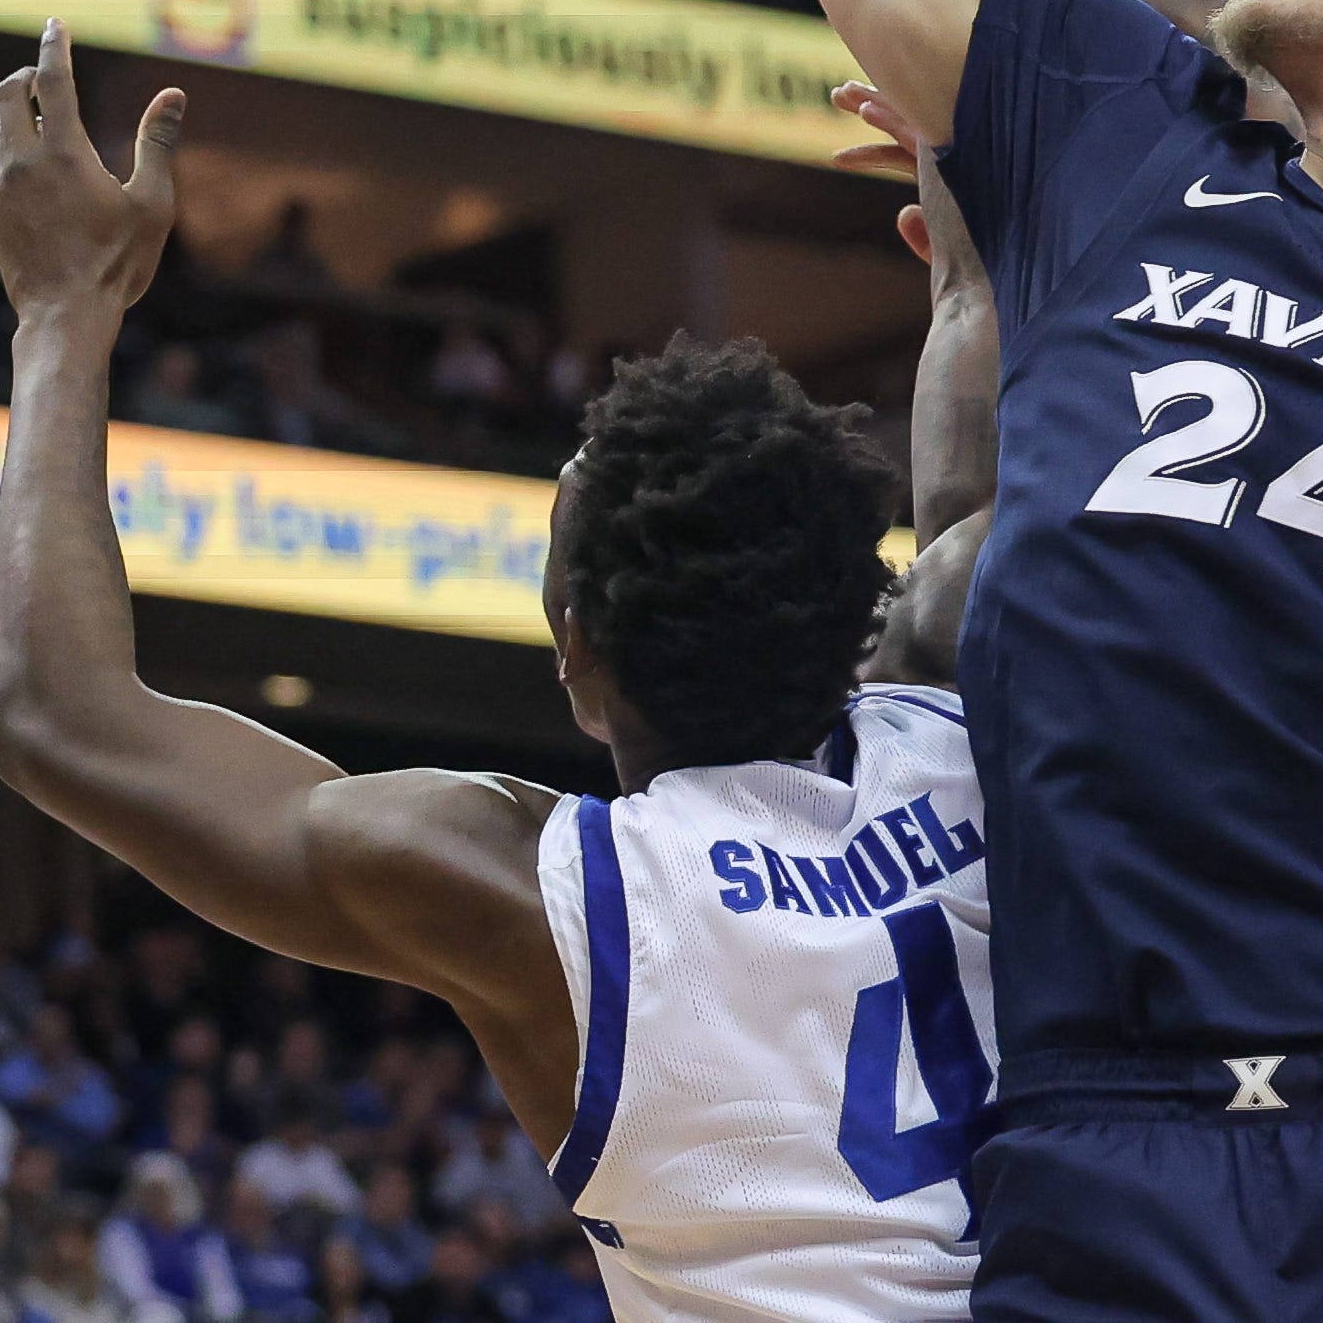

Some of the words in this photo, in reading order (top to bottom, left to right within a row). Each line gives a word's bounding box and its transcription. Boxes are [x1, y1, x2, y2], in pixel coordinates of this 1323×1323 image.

[709, 790, 986, 917] SAMUEL
[837, 899, 997, 1241] 4
[1222, 1055, 1290, 1111] X
